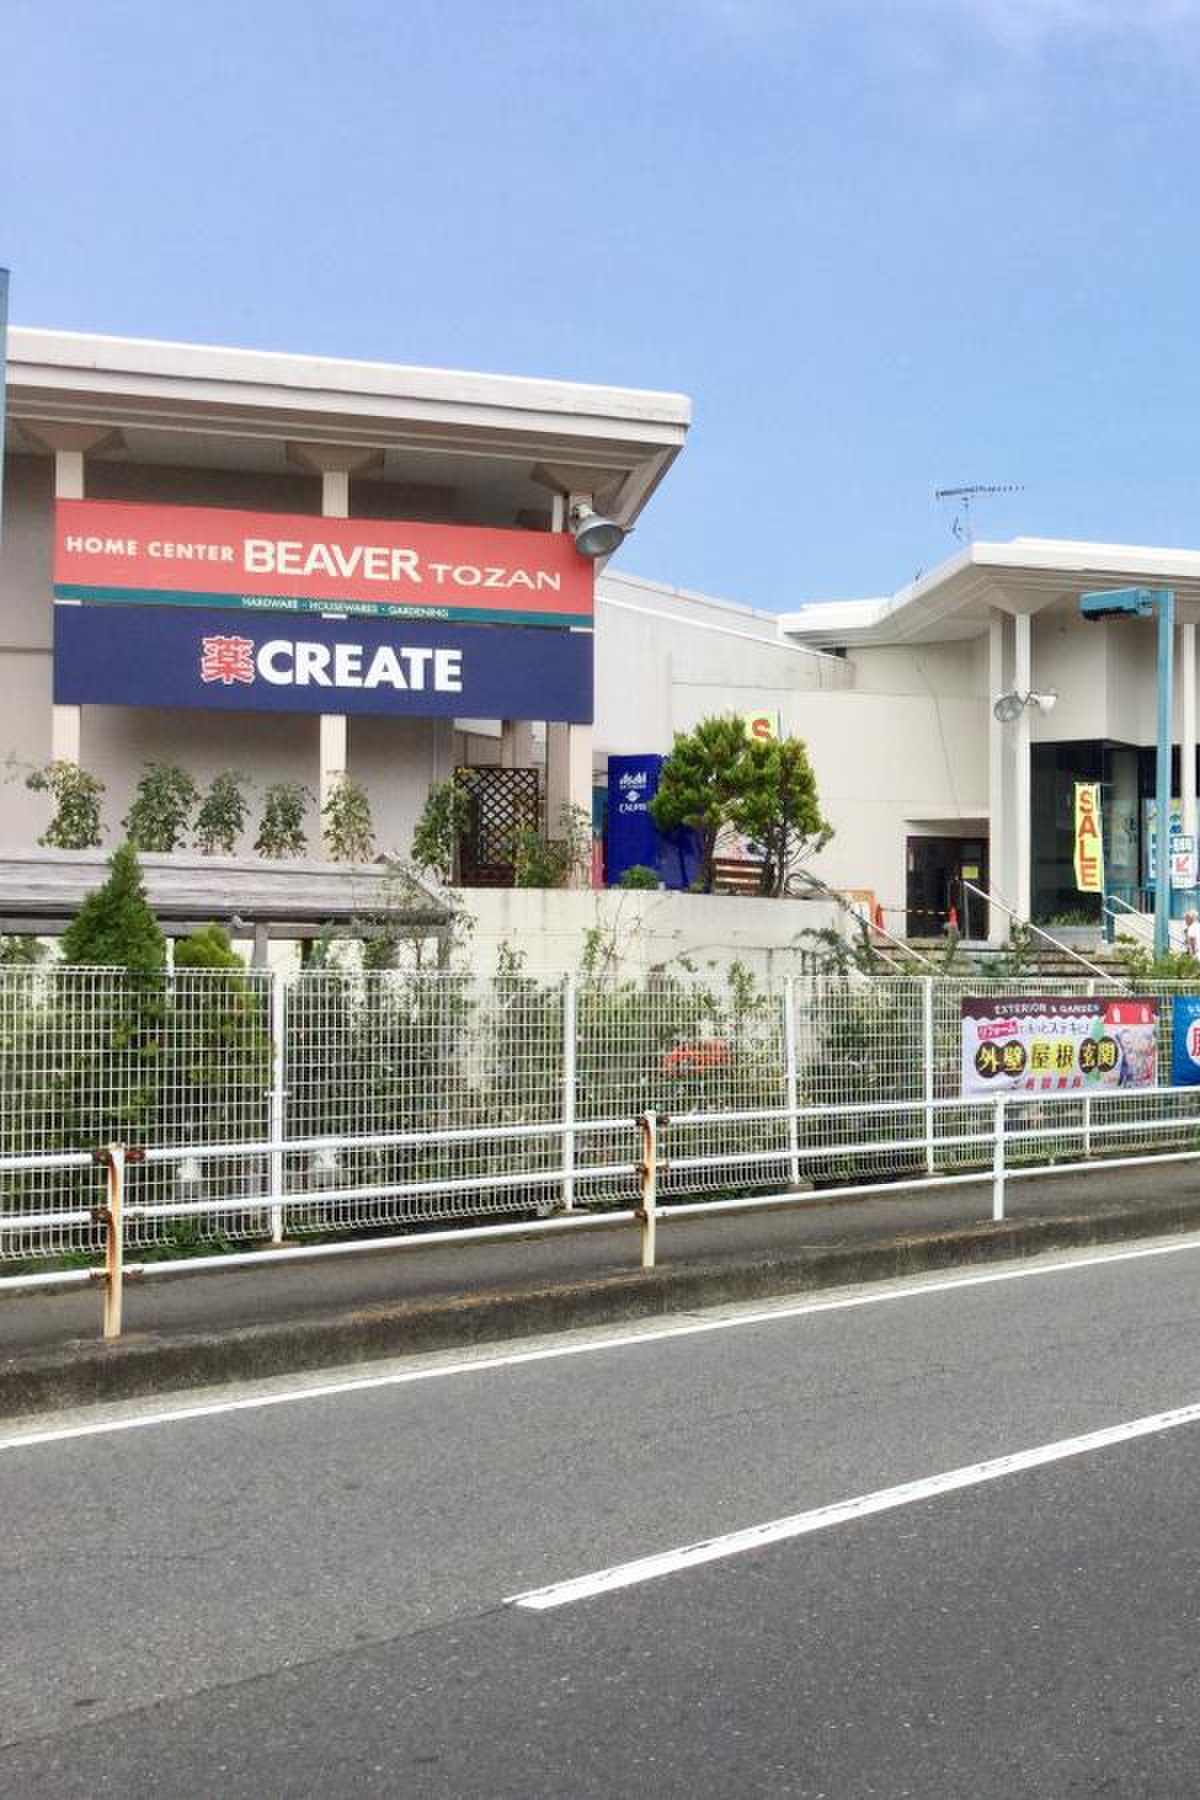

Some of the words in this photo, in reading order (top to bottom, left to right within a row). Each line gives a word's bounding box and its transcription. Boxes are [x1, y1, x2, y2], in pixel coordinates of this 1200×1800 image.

[66, 534, 138, 556] HOME
[148, 541, 235, 562] CENTER
[243, 539, 422, 583] BEAVER
[428, 562, 562, 592] TOZAN
[241, 597, 298, 609] HARDWARE
[200, 635, 255, 684] 薬
[256, 639, 464, 693] CREATE
[1078, 789, 1098, 887] SALE
